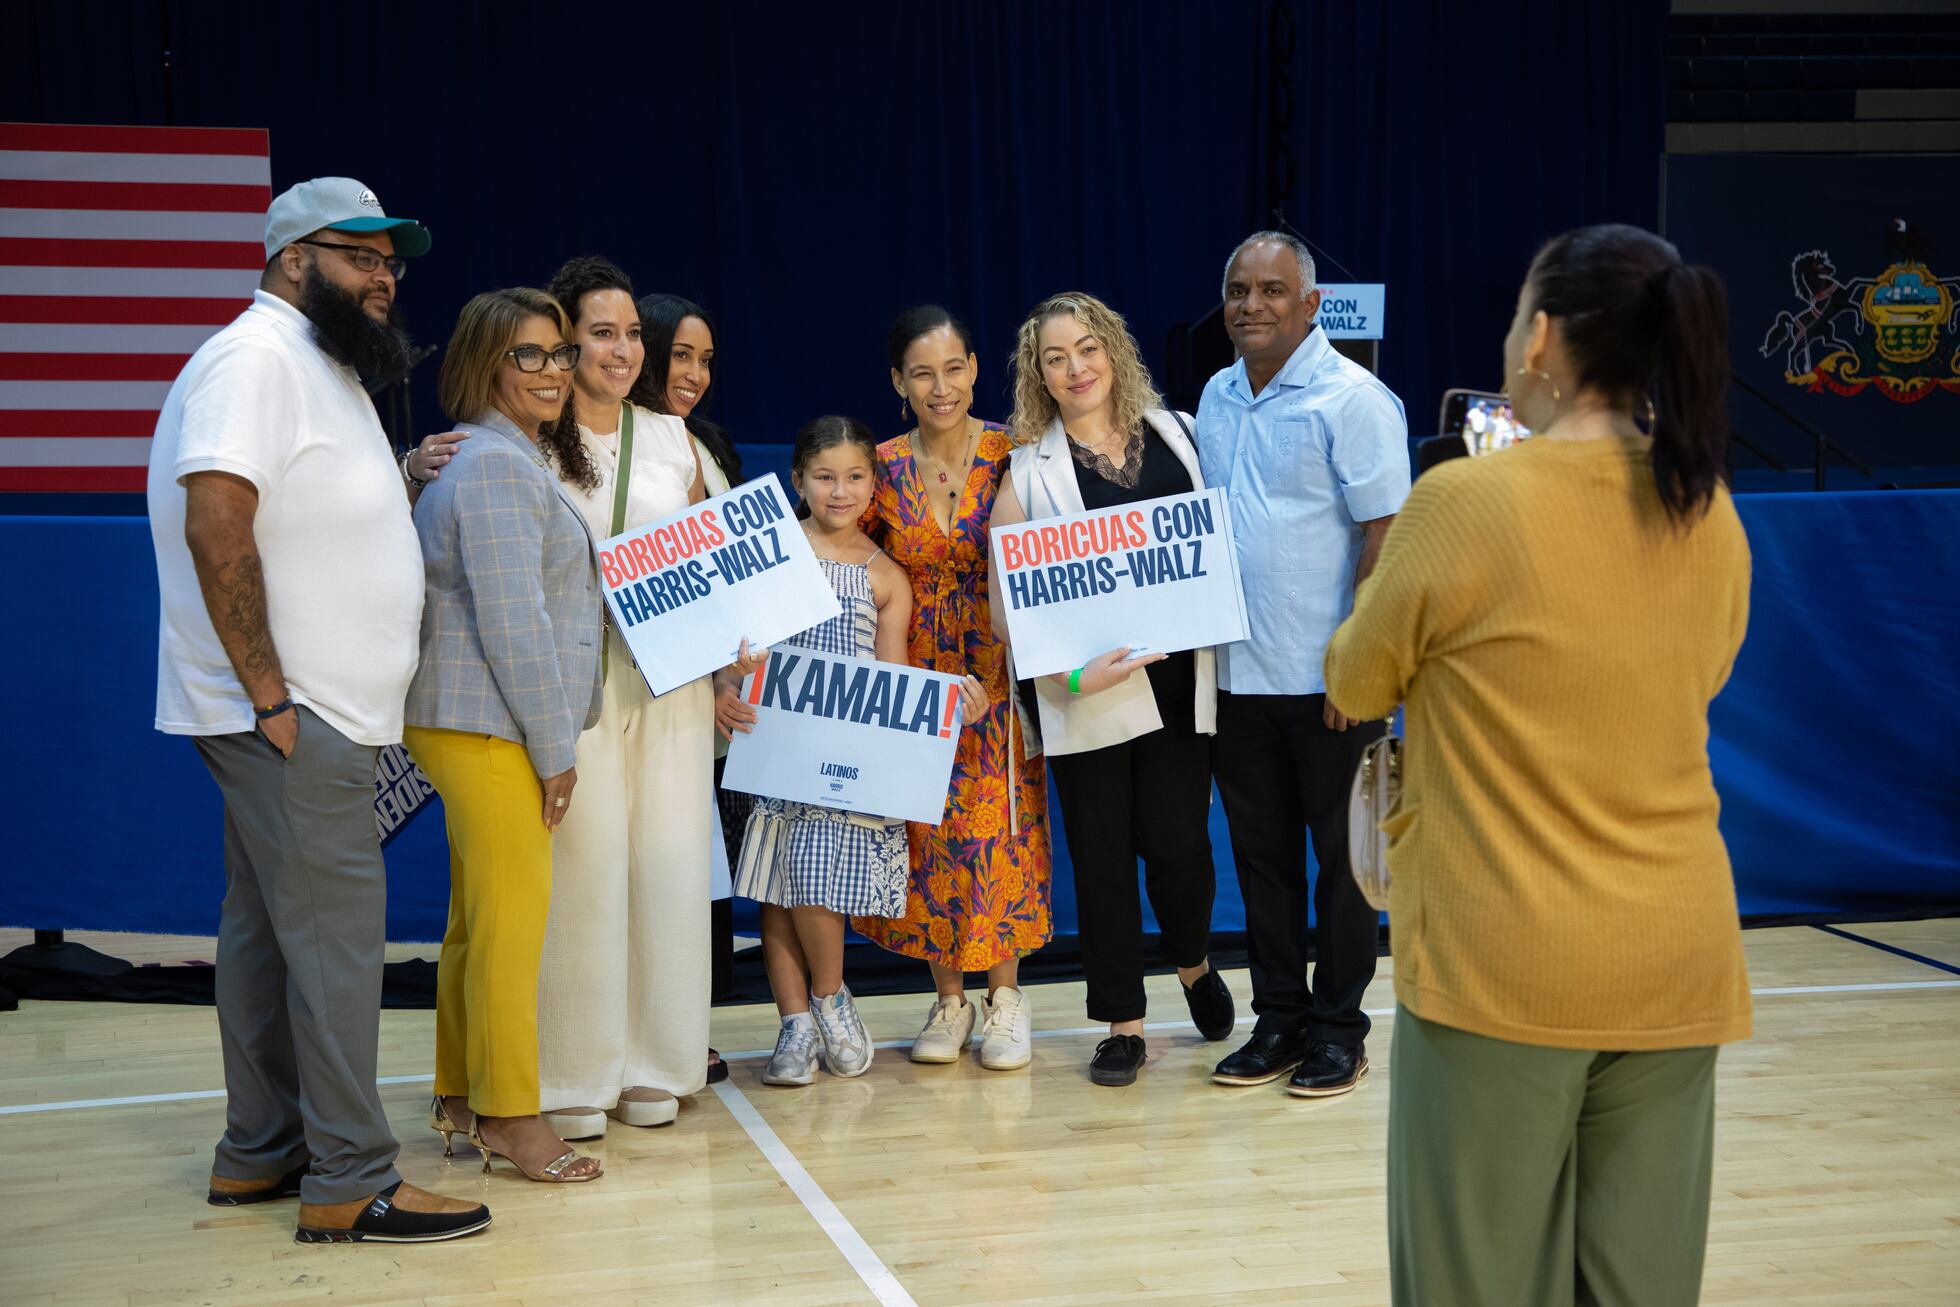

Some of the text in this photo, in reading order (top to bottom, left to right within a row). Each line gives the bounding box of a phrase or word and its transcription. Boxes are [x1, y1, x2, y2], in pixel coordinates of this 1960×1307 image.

[1320, 316, 1367, 331] WALZ
[1321, 299, 1357, 314] CON
[599, 484, 785, 590] BORICUAS CON
[1000, 498, 1215, 571] BORICUAS CON
[613, 526, 790, 628] HARRIS-WALZ
[1007, 540, 1207, 610] HARRIS-WALZ
[375, 767, 435, 842] SIDEN
[820, 762, 859, 780] LATINOS
